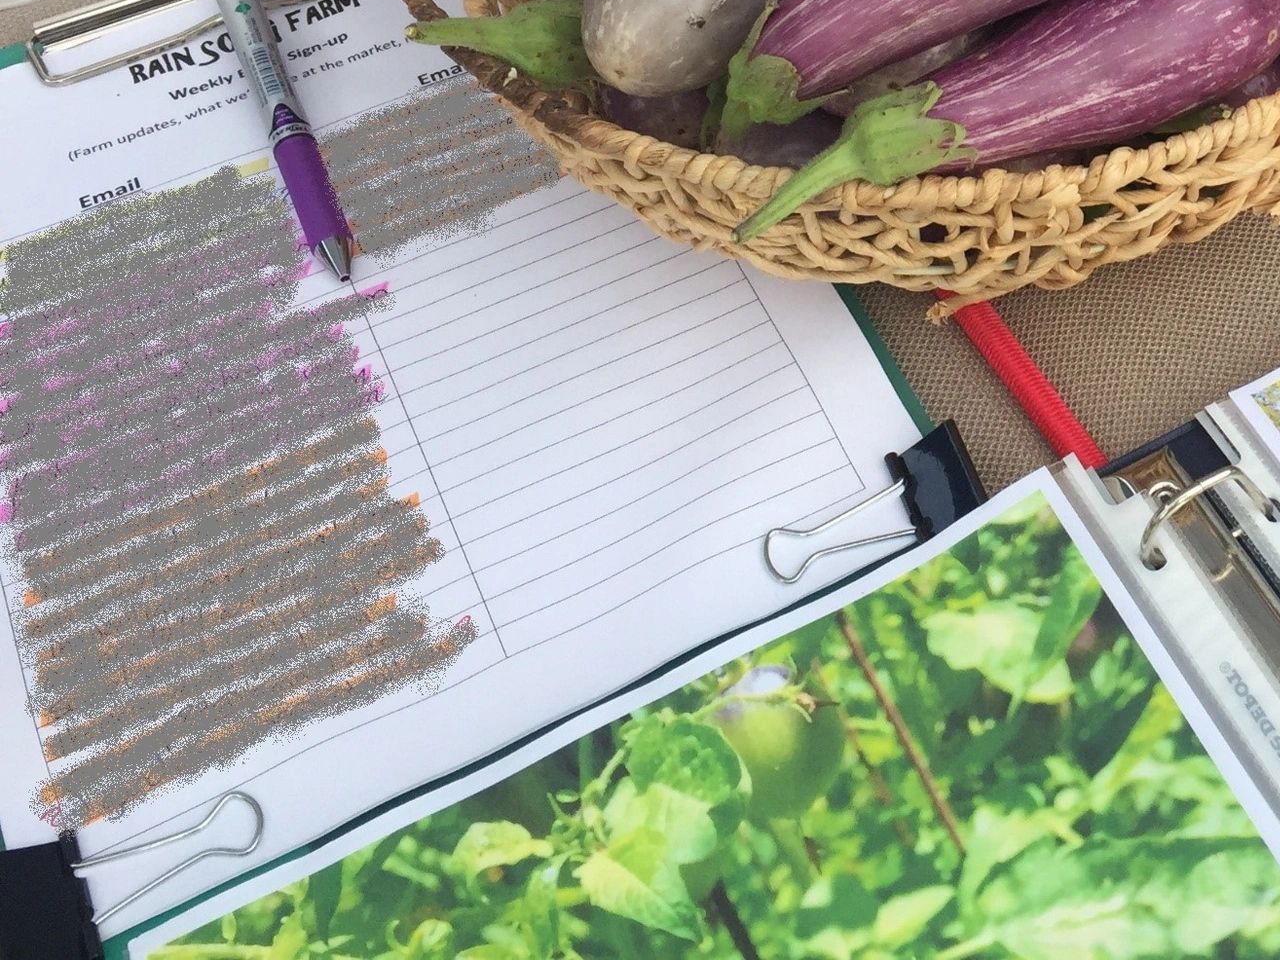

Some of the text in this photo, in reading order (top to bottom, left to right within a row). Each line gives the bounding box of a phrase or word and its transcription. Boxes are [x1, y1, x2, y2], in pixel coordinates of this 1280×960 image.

[128, 46, 196, 84] RAIN
[168, 74, 233, 100] Weekly
[287, 32, 349, 61] Sign-up
[417, 64, 463, 86] Ema
[68, 141, 114, 162] (Farm
[116, 118, 182, 144] updates,
[185, 101, 222, 120] what
[302, 67, 318, 79] at
[320, 59, 345, 72] the
[347, 38, 403, 64] market,
[79, 176, 142, 209] Email
